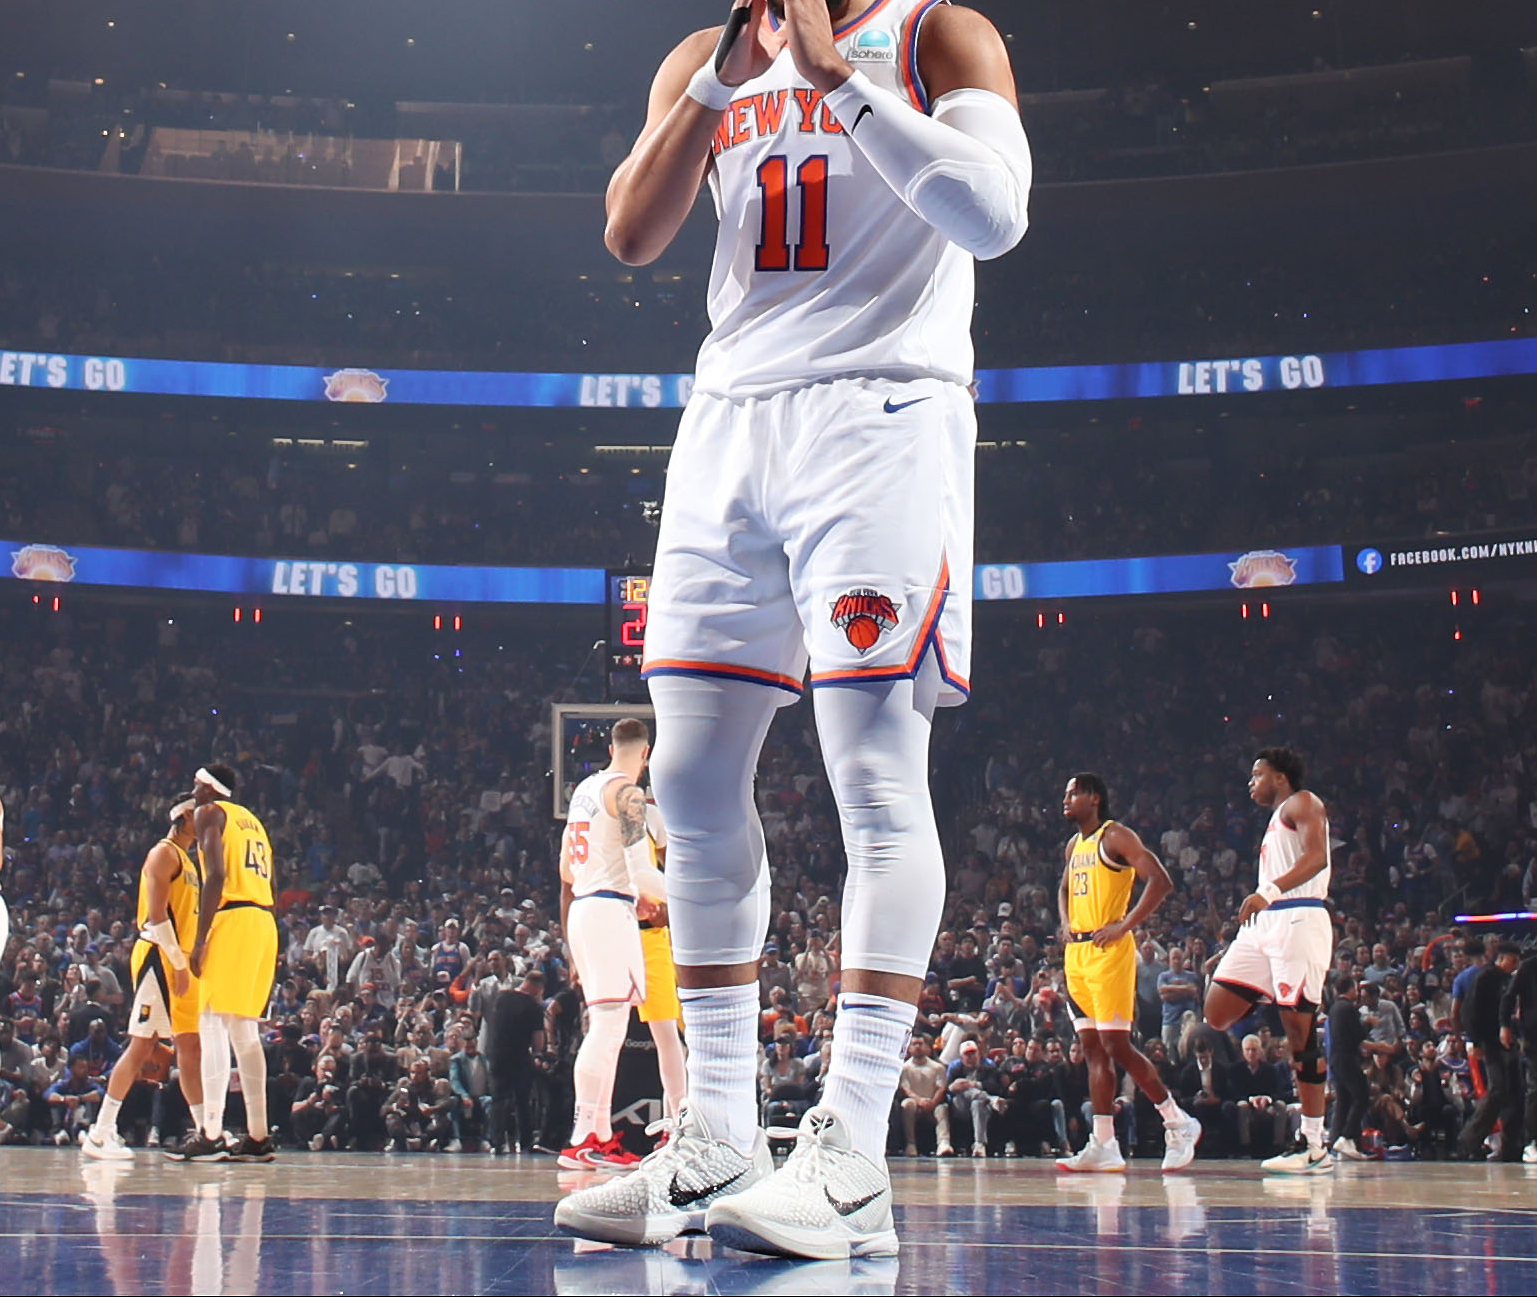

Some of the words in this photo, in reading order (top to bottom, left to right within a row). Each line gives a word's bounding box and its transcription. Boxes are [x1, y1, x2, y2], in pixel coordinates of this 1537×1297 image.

[851, 48, 893, 61] sphere
[713, 88, 788, 154] NEW
[754, 154, 829, 271] 11
[84, 358, 125, 391] GO
[580, 375, 661, 407] LET'S
[677, 376, 695, 406] G
[1178, 359, 1263, 394] LET'S
[1280, 355, 1324, 389] GO
[272, 561, 358, 597] LET'S
[375, 566, 417, 599] GO
[982, 566, 1024, 600] GO
[831, 595, 899, 623] KNICKS
[245, 839, 268, 878] 43
[1074, 872, 1088, 896] 23
